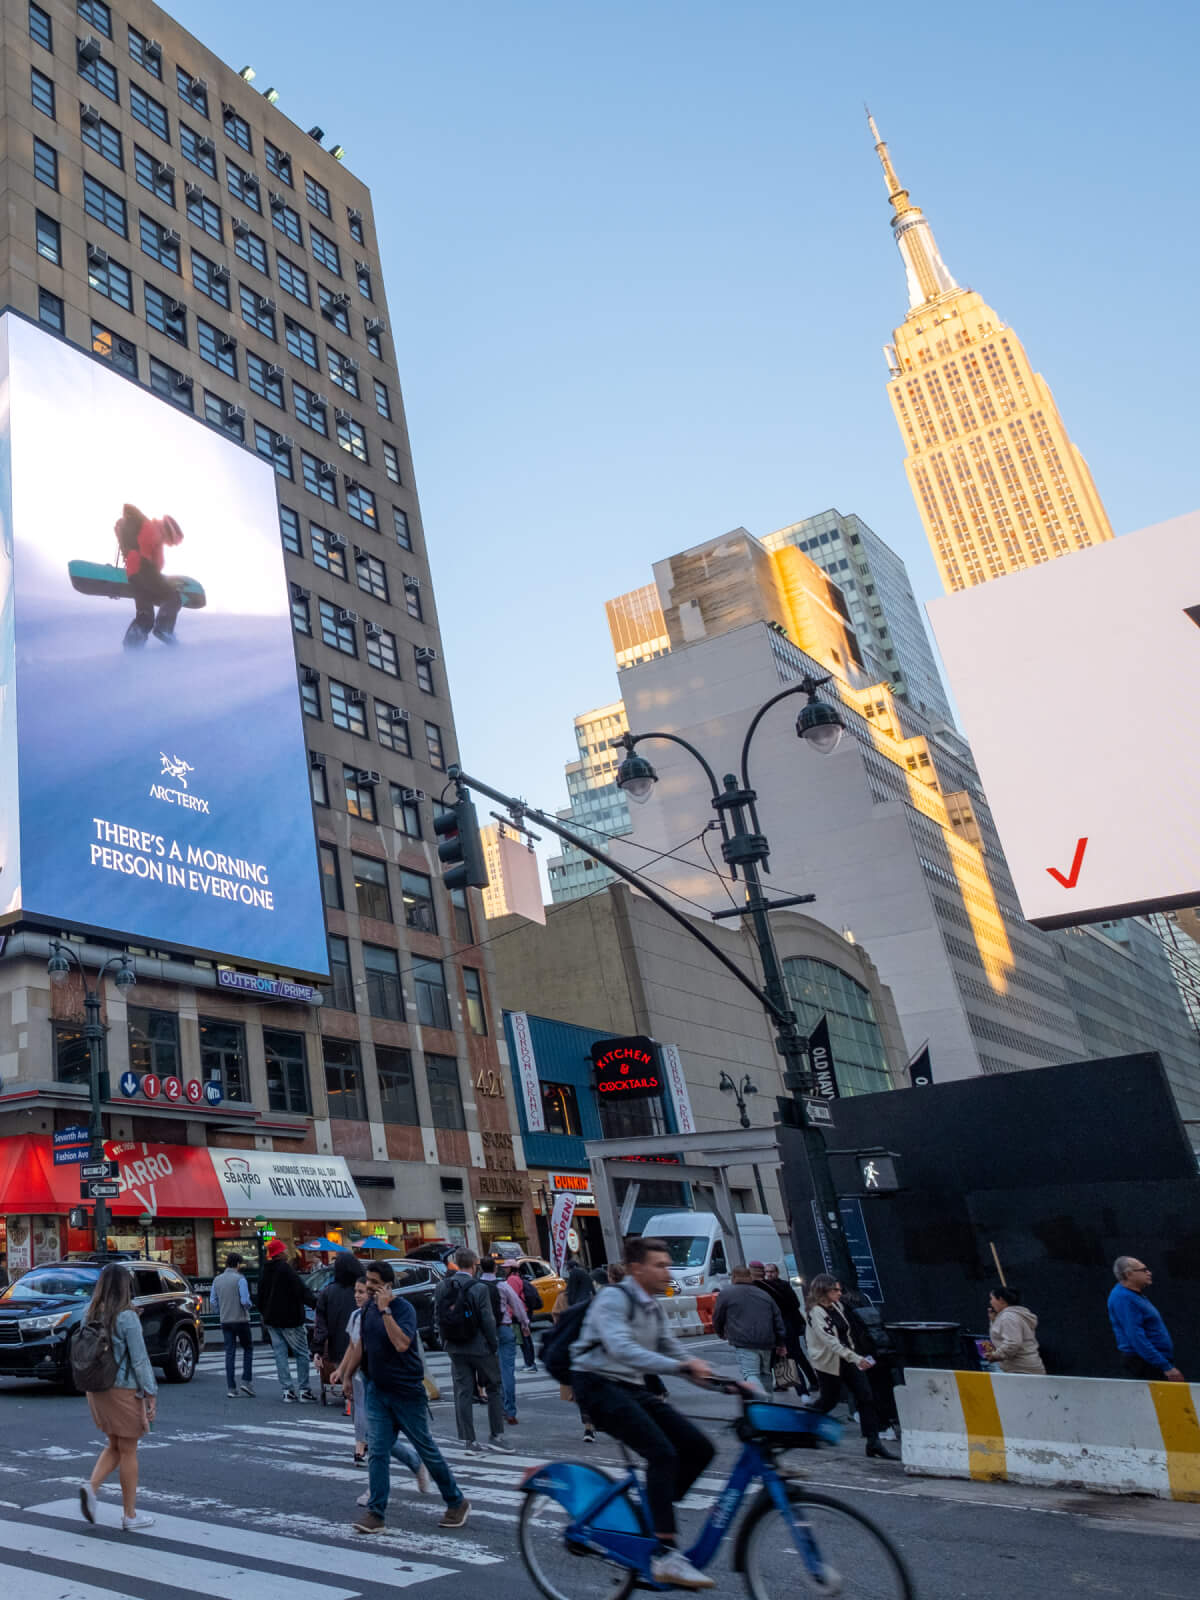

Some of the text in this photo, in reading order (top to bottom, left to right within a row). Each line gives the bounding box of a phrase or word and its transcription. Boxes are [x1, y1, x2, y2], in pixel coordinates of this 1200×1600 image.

[93, 817, 269, 885] THERE'S A MORNING
[90, 843, 274, 911] PERSON IN EVERYONE
[596, 1048, 652, 1069] KITCHEN
[812, 1047, 829, 1070] OLD
[599, 1076, 658, 1092] COCKTAILS
[54, 1131, 88, 1142] Seventh Ave
[56, 1152, 77, 1161] Fashion
[117, 1152, 173, 1193] BARRO
[223, 1172, 261, 1185] SBARRO
[301, 1166, 316, 1176] FRESH
[317, 1168, 327, 1177] ALL
[327, 1169, 337, 1177] DAY
[269, 1177, 354, 1199] NEW YORK PIZZA
